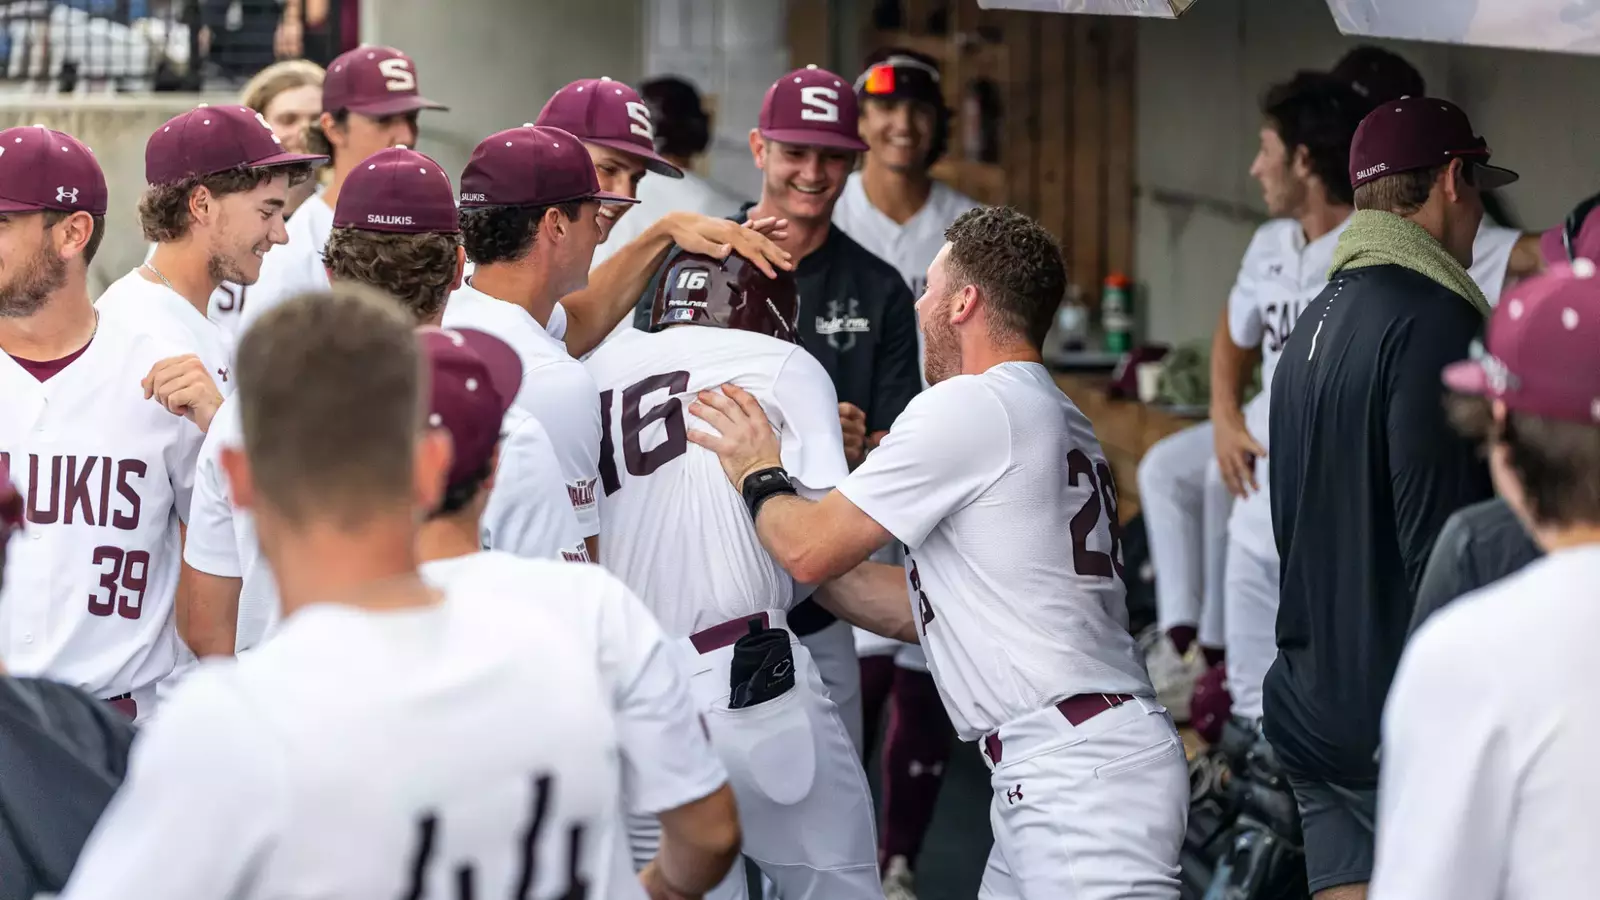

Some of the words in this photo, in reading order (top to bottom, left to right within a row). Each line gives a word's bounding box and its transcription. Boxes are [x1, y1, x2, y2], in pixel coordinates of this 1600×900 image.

[378, 58, 415, 91] S
[625, 102, 653, 140] S
[801, 86, 838, 122] S
[1356, 162, 1386, 180] SALUKIS
[461, 192, 485, 201] SALUKIS
[367, 214, 412, 225] SALUKIS
[677, 271, 708, 290] 16
[598, 370, 690, 497] 16
[0, 452, 148, 530] UKIS
[88, 545, 150, 620] 39
